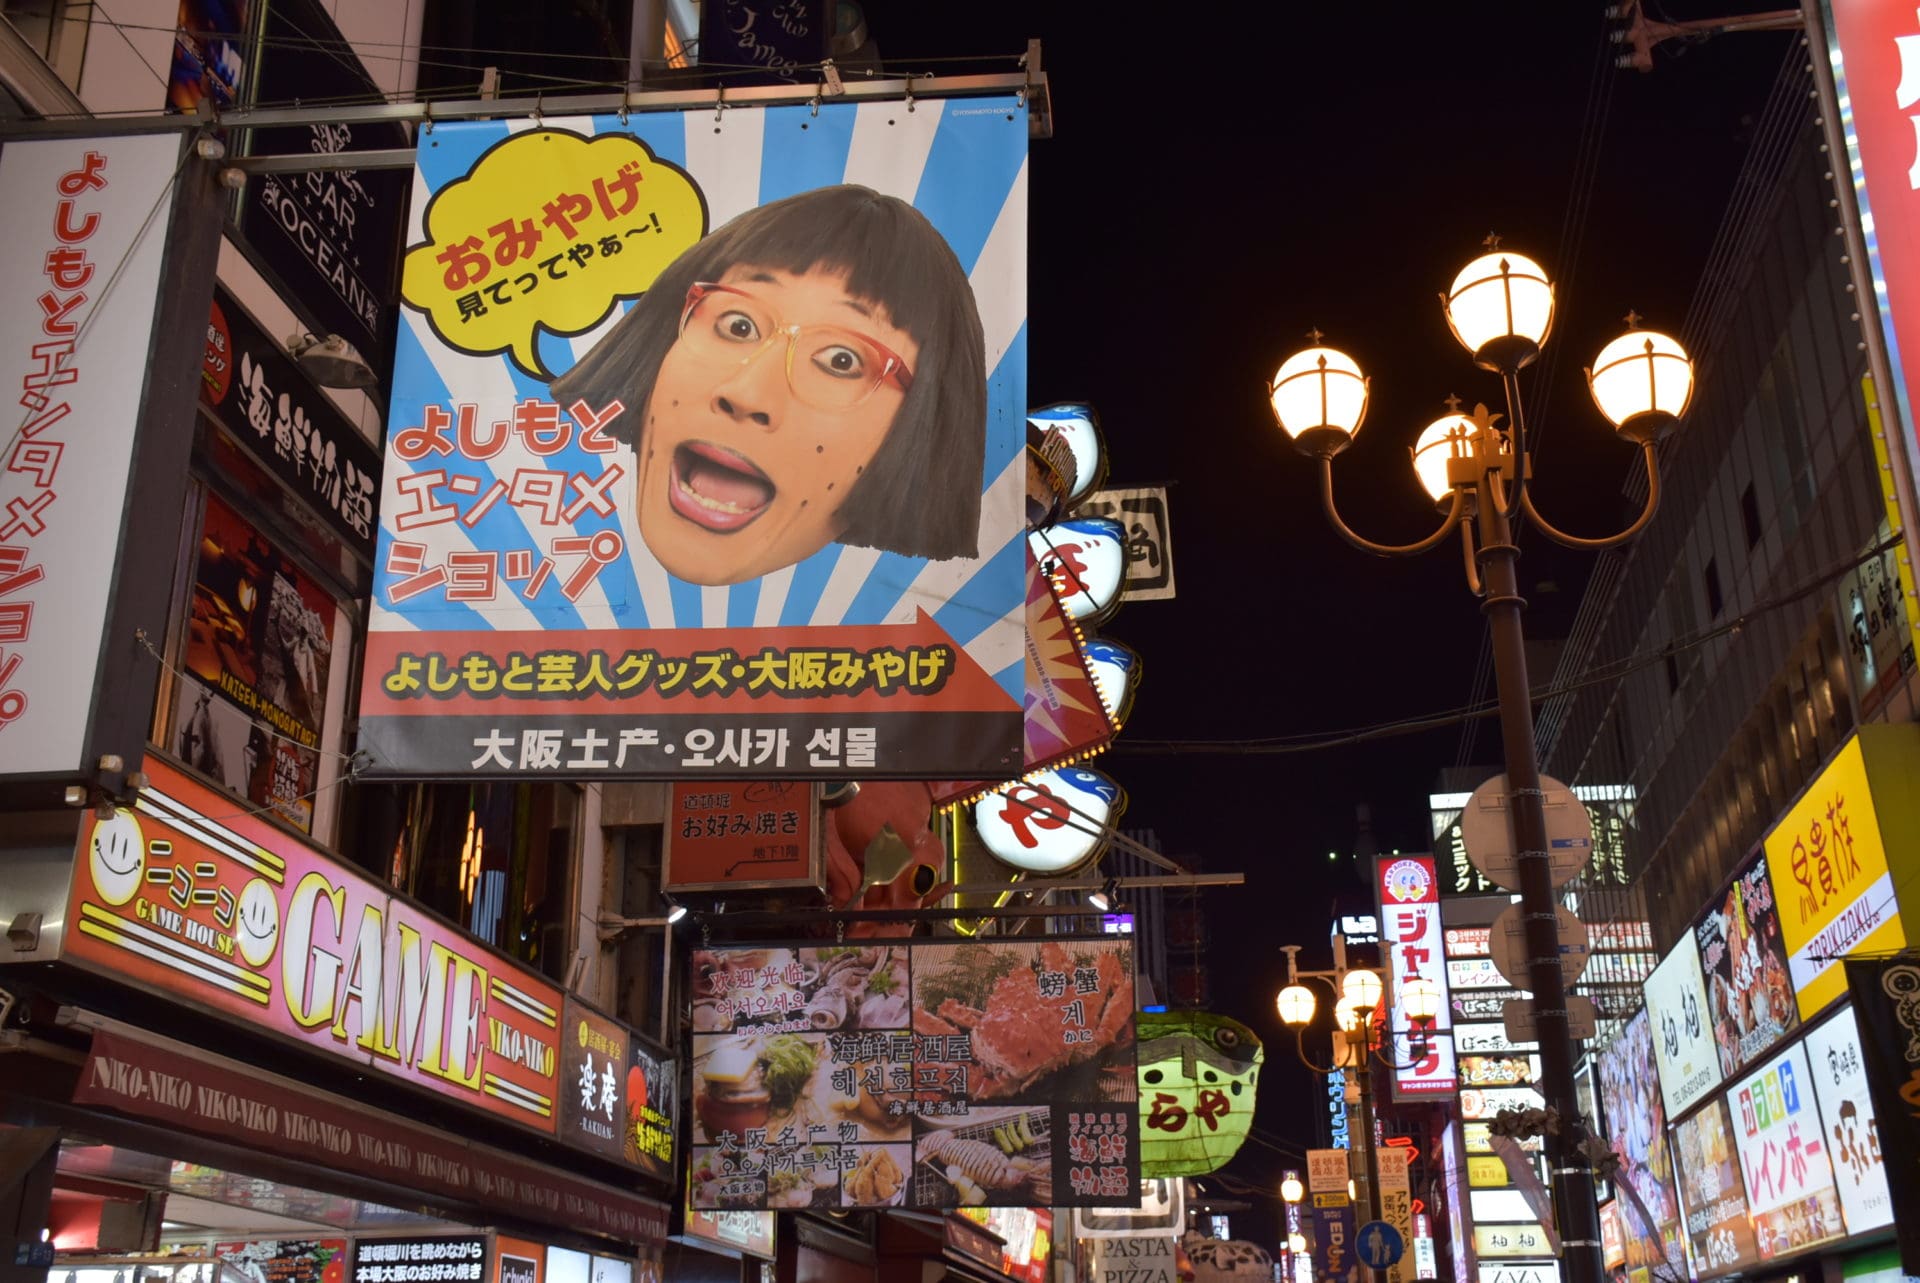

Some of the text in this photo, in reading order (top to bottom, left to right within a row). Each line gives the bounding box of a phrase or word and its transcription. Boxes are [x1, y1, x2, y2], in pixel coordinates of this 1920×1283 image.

[730, 6, 799, 77] James
[306, 170, 356, 241] BAR
[435, 160, 643, 291] おみやげ
[280, 198, 366, 317] OCEAN
[393, 398, 625, 460] よしもと
[396, 463, 624, 532] エンタメ
[386, 529, 623, 604] ショップ
[384, 648, 948, 693] よしもと芸人グッズ・大阪みやげ
[220, 670, 318, 749] KAISEN-MONOGATARI
[806, 728, 877, 767] 선물
[683, 792, 731, 810] 道頓堀
[998, 784, 1072, 849] や
[682, 811, 800, 839] お好み焼き
[146, 840, 237, 929] ニコニコ
[136, 897, 235, 957] GAME HOUSE
[1807, 896, 1873, 973] TORIKIZOKU
[281, 871, 490, 1092] GAME
[709, 963, 806, 994] 欢迎光临
[1039, 968, 1100, 997] 螃蟹
[716, 992, 809, 1020] 어서오세요
[1061, 1000, 1086, 1026] 게
[487, 1016, 555, 1078] NIKO-NIKO
[831, 1035, 973, 1065] 海鮮居酒屋
[1063, 1029, 1094, 1044] かに
[90, 1056, 192, 1110] NIKO-NIKO
[195, 1086, 278, 1134] NIKO-NIKO
[282, 1111, 351, 1155] NIKO-NIKO
[579, 1052, 618, 1121] 楽庵
[1738, 1060, 1801, 1138] カラオケ
[1139, 1089, 1231, 1133] らや
[715, 1121, 859, 1152] 大阪名产物
[719, 1148, 860, 1179] 오오사까특산품
[1743, 1122, 1822, 1205] レインボー
[719, 1182, 766, 1195] 大阪名物
[358, 1242, 482, 1262] 道頓堀川を眺めながら
[1101, 1239, 1171, 1257] PASTA
[1491, 1232, 1536, 1247] 柚柚
[356, 1263, 482, 1283] 本場大阪のお好み焼き
[1104, 1269, 1170, 1283] PIZZA
